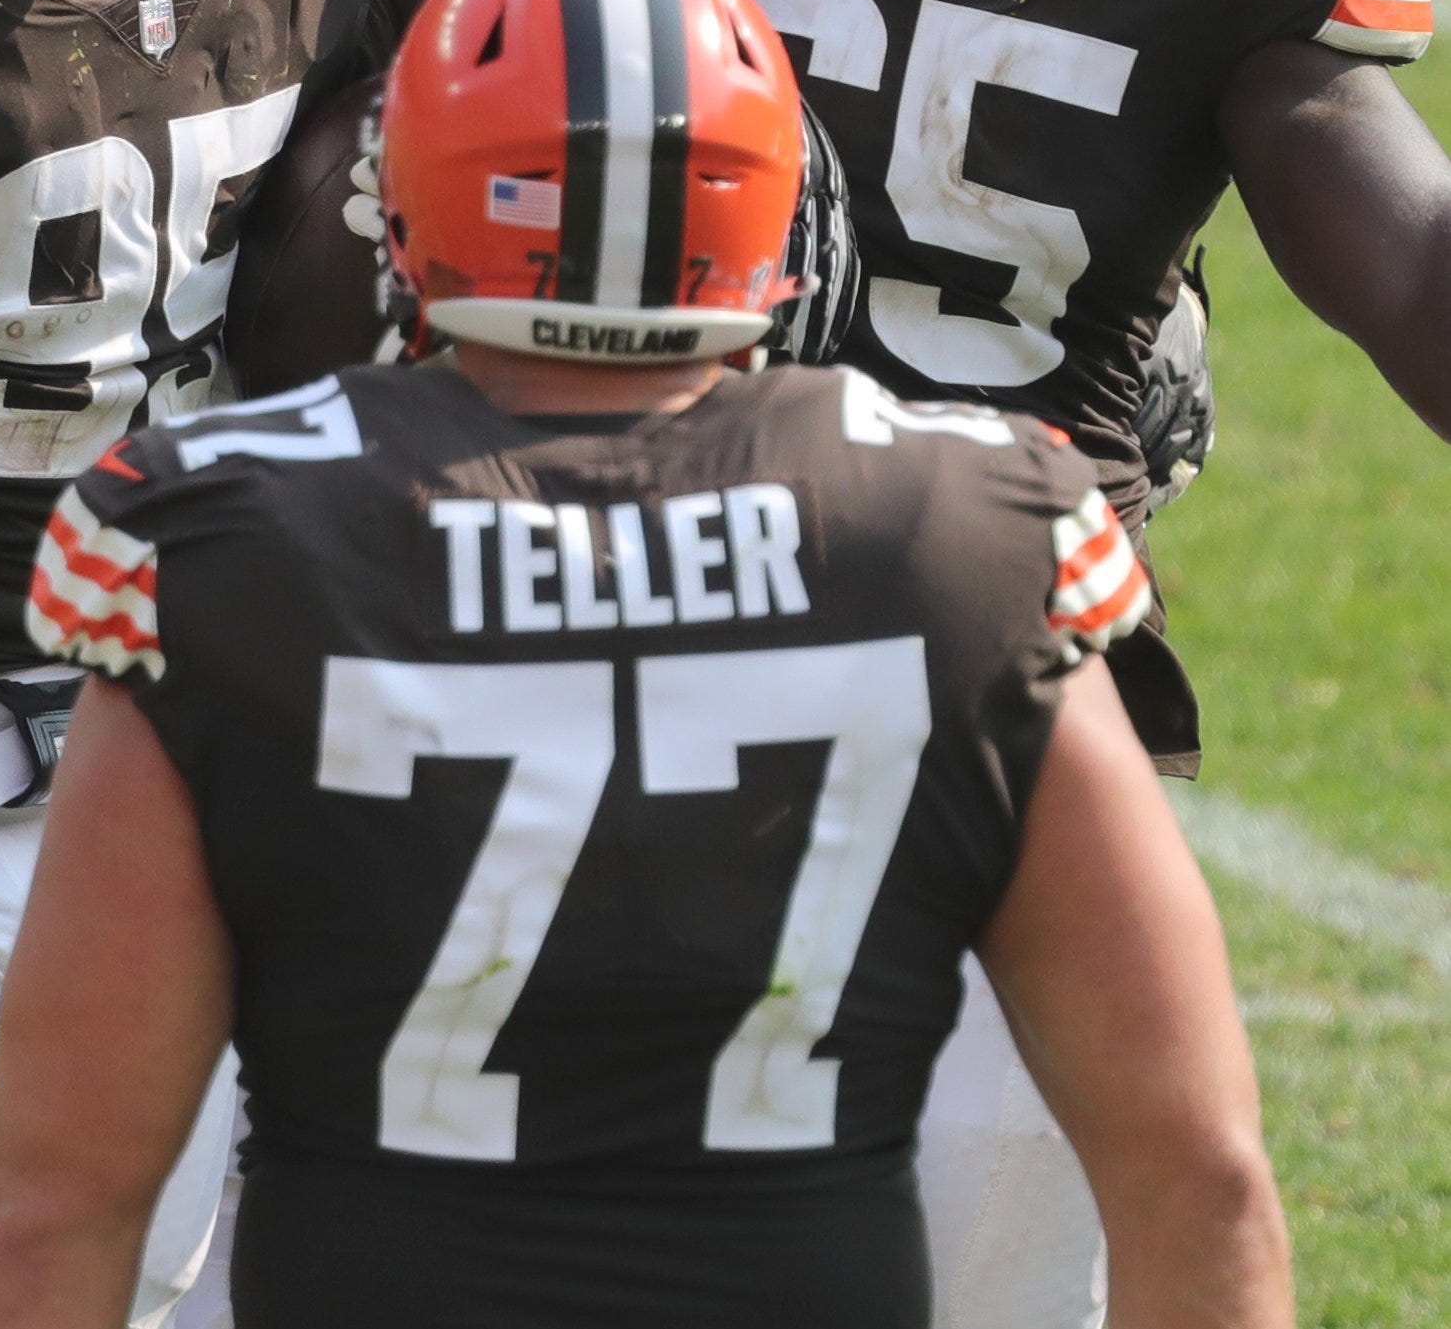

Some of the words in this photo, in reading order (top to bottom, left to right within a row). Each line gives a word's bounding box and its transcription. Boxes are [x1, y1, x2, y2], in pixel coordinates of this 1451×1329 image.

[532, 318, 701, 354] CLEVELAND
[428, 483, 811, 634] TELLER
[316, 634, 933, 1162] 77
